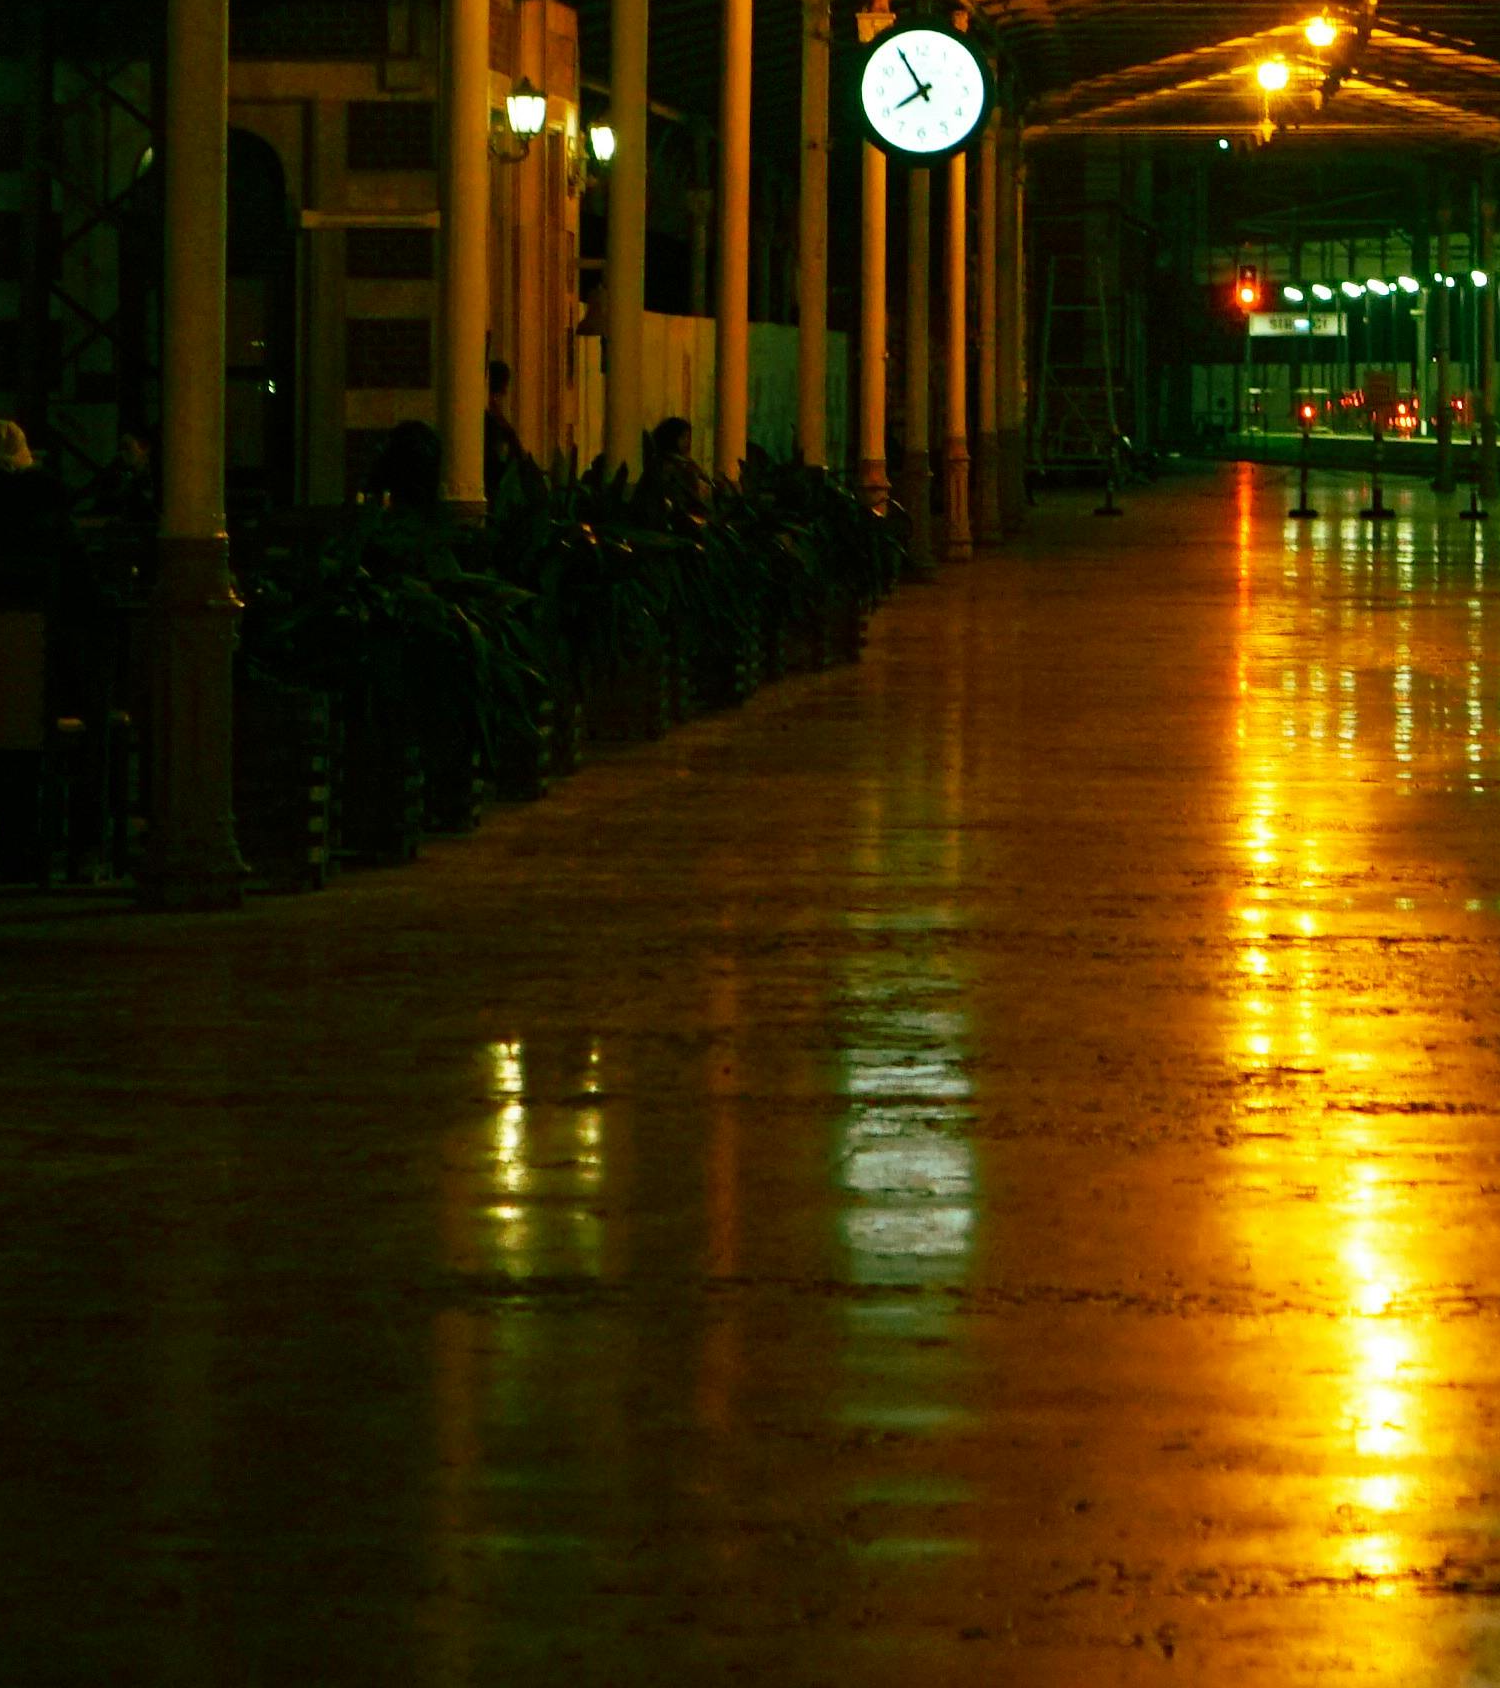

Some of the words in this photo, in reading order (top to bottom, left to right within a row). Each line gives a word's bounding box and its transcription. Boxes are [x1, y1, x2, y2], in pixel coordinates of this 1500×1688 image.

[915, 43, 929, 56] 12
[955, 106, 962, 117] 4
[898, 121, 906, 132] 7
[917, 128, 926, 139] 6
